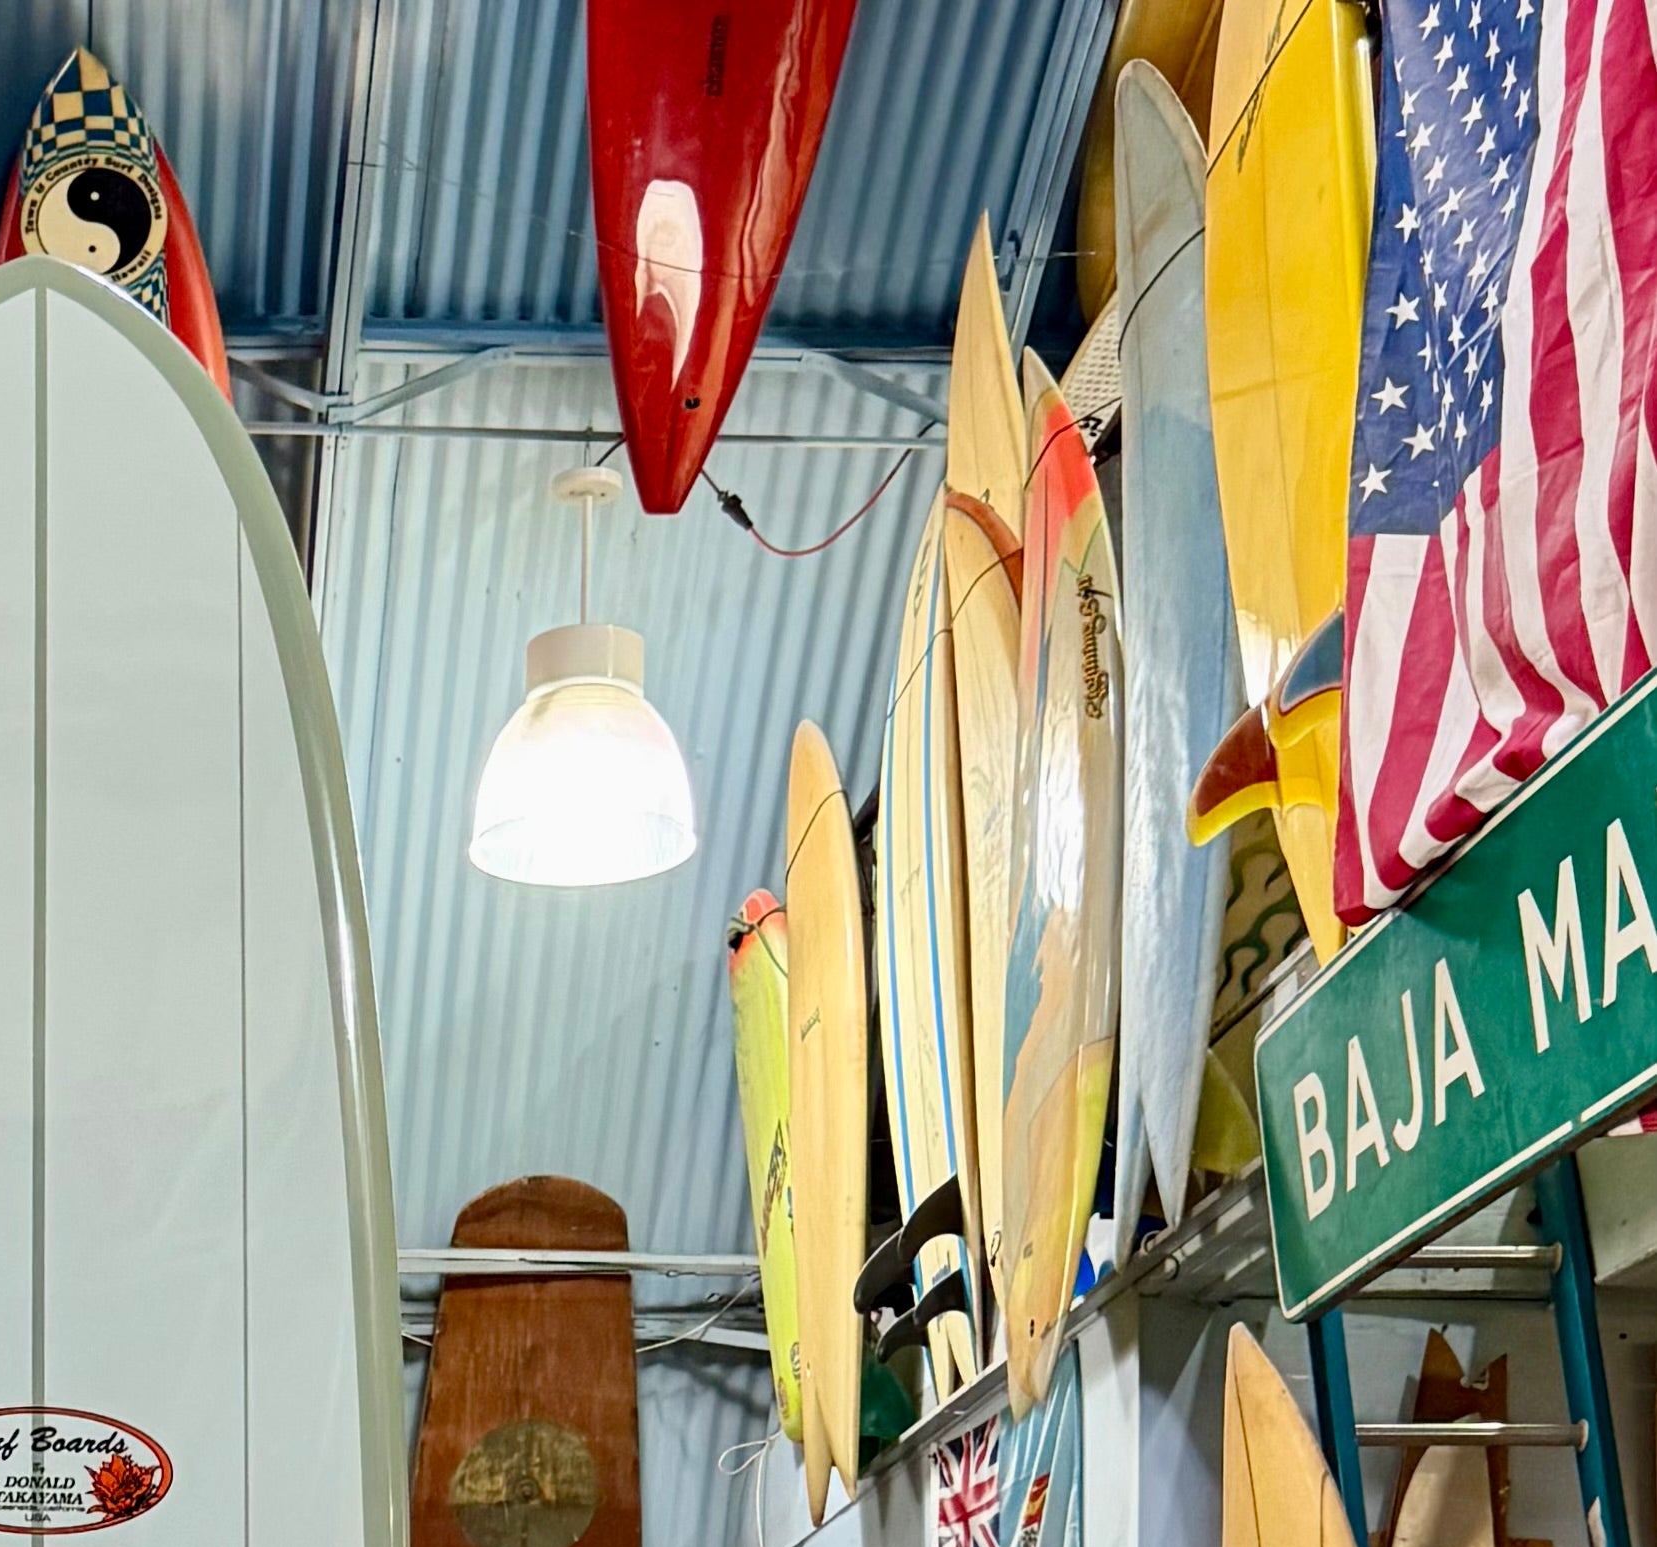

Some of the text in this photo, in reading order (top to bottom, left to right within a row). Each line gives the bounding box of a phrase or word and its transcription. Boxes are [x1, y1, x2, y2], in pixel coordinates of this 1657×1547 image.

[25, 200, 37, 234] Town
[45, 157, 99, 182] Country
[104, 157, 135, 172] Surf
[137, 173, 162, 220] Designs
[1294, 957, 1485, 1221] BAJA
[29, 1426, 129, 1454] Boards
[4, 1476, 76, 1490] DONALD
[24, 1513, 51, 1522] USA
